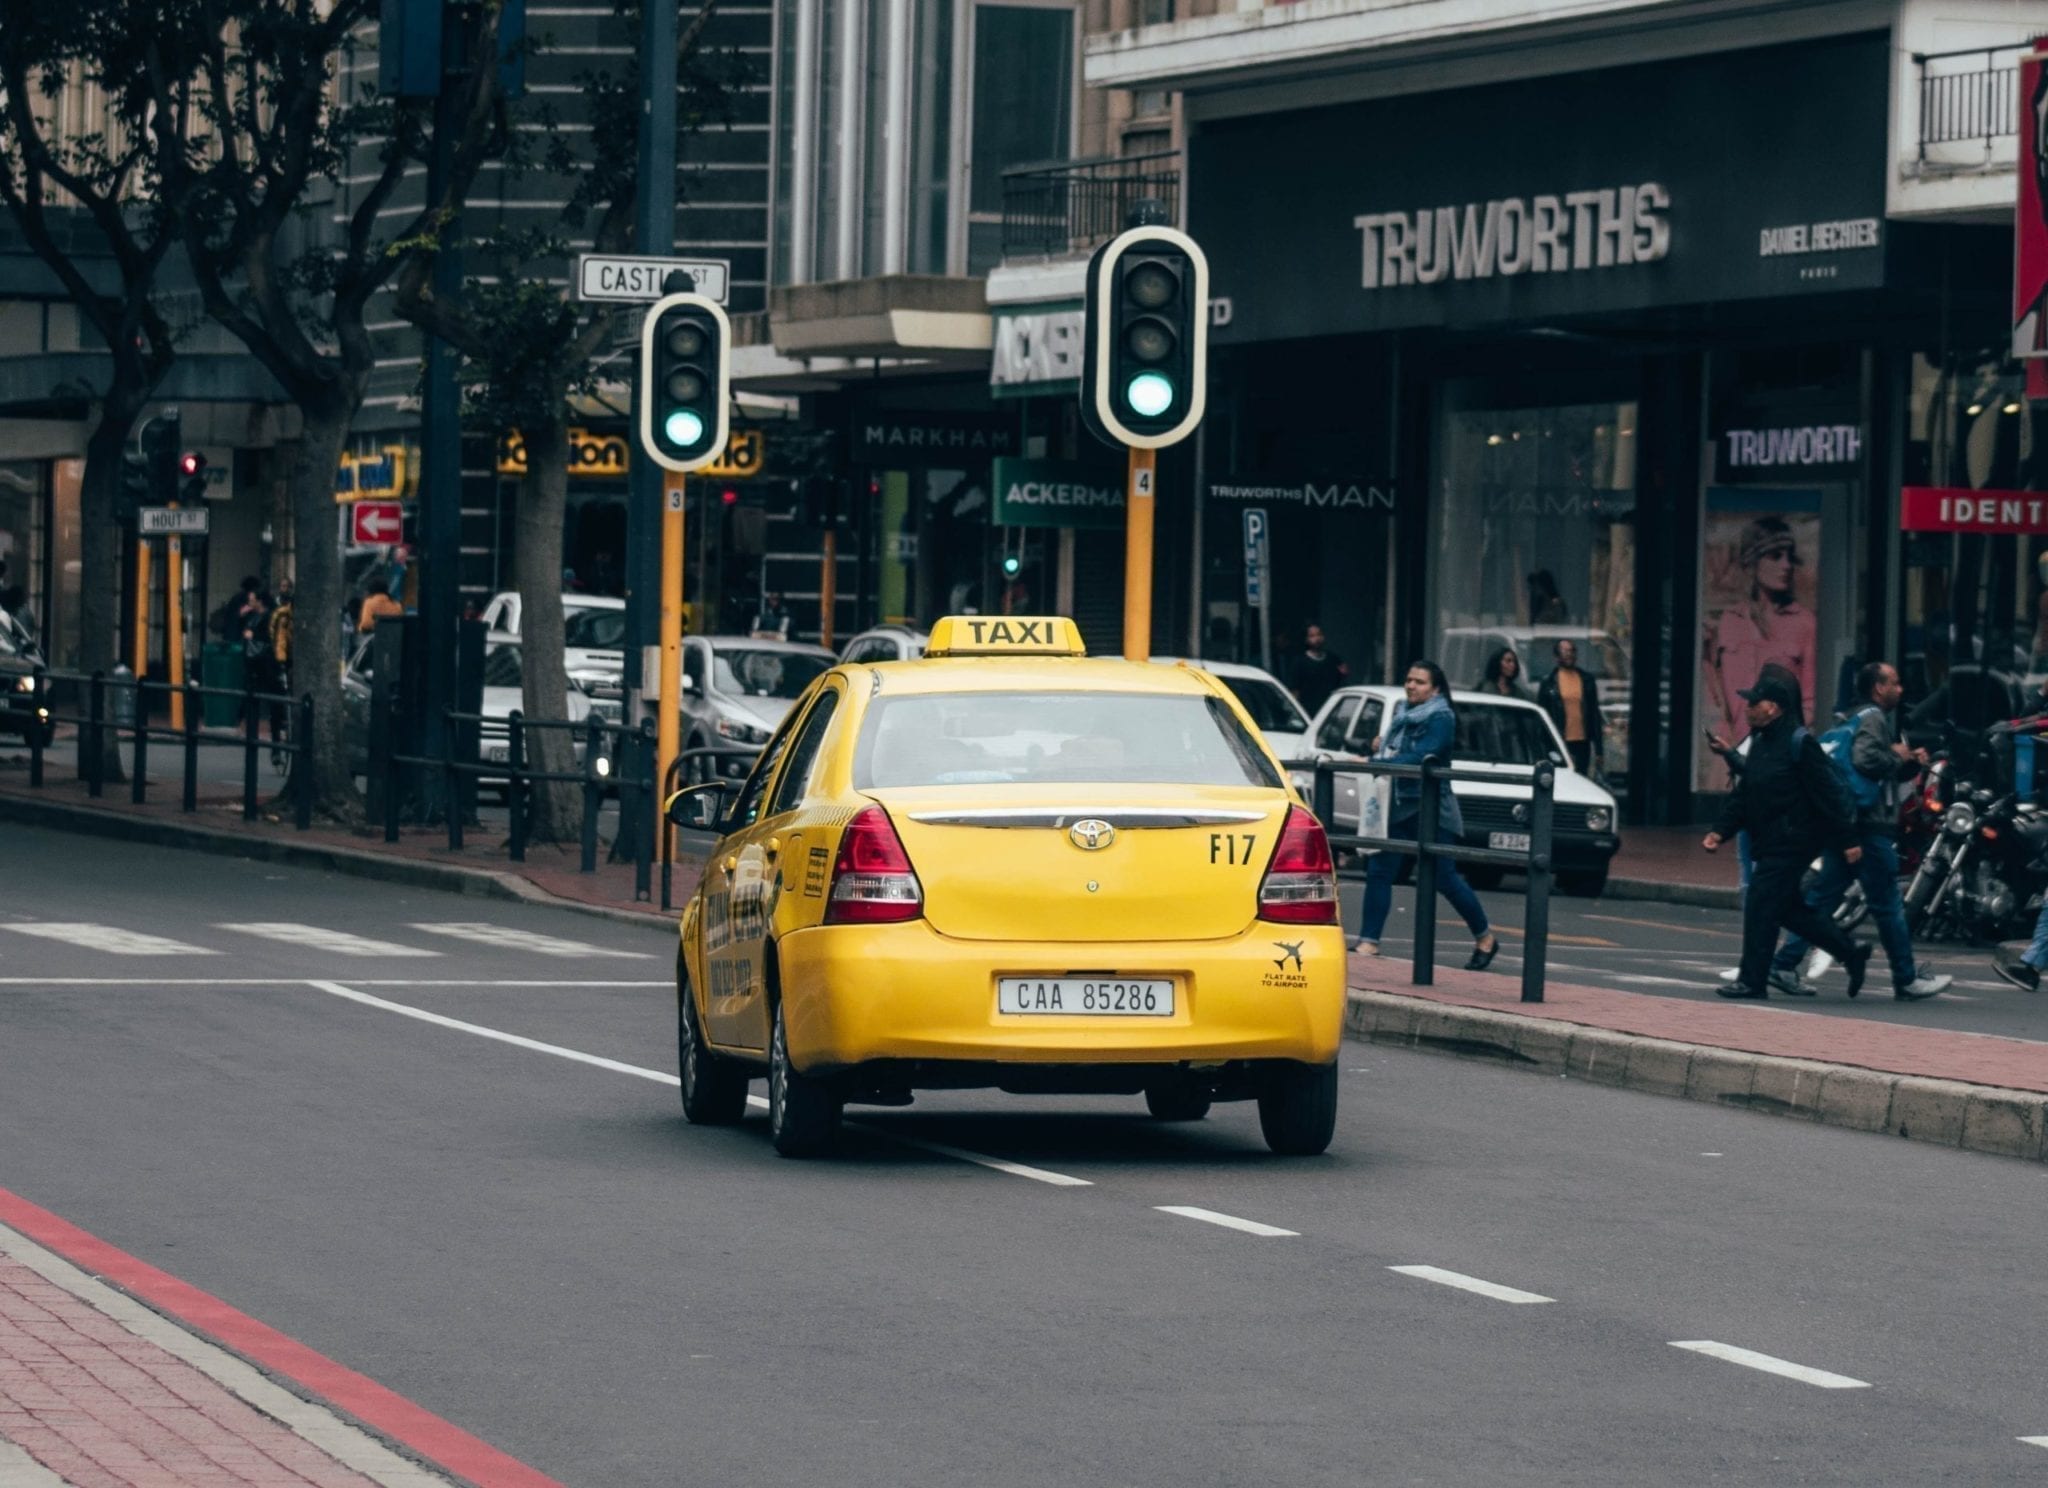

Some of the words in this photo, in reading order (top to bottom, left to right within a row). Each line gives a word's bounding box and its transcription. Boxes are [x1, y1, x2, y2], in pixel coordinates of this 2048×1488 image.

[1354, 183, 1669, 288] TRUWORTHS
[1760, 226, 1809, 256] DANIEL
[1811, 218, 1879, 250] HECHTER
[601, 266, 665, 292] CASTL
[693, 269, 707, 284] ST
[991, 311, 1085, 384] ACKE
[865, 426, 1008, 445] MARKHAM
[1727, 425, 1860, 466] TRUWORTH
[1006, 482, 1126, 506] ACKERMA
[1139, 474, 1150, 492] 4
[1211, 486, 1301, 499] TRUWORTHS
[1304, 483, 1395, 508] MAN
[672, 492, 681, 508] 3
[1940, 498, 2042, 525] IDENT
[151, 512, 182, 527] HOUT
[968, 621, 1053, 644] TAXI
[1211, 834, 1256, 865] F17
[1265, 973, 1284, 981] FLAT
[1287, 974, 1306, 982] RATE
[1274, 980, 1308, 989] AIRPORT
[1018, 983, 1063, 1009] CAA
[1083, 984, 1156, 1011] 85286
